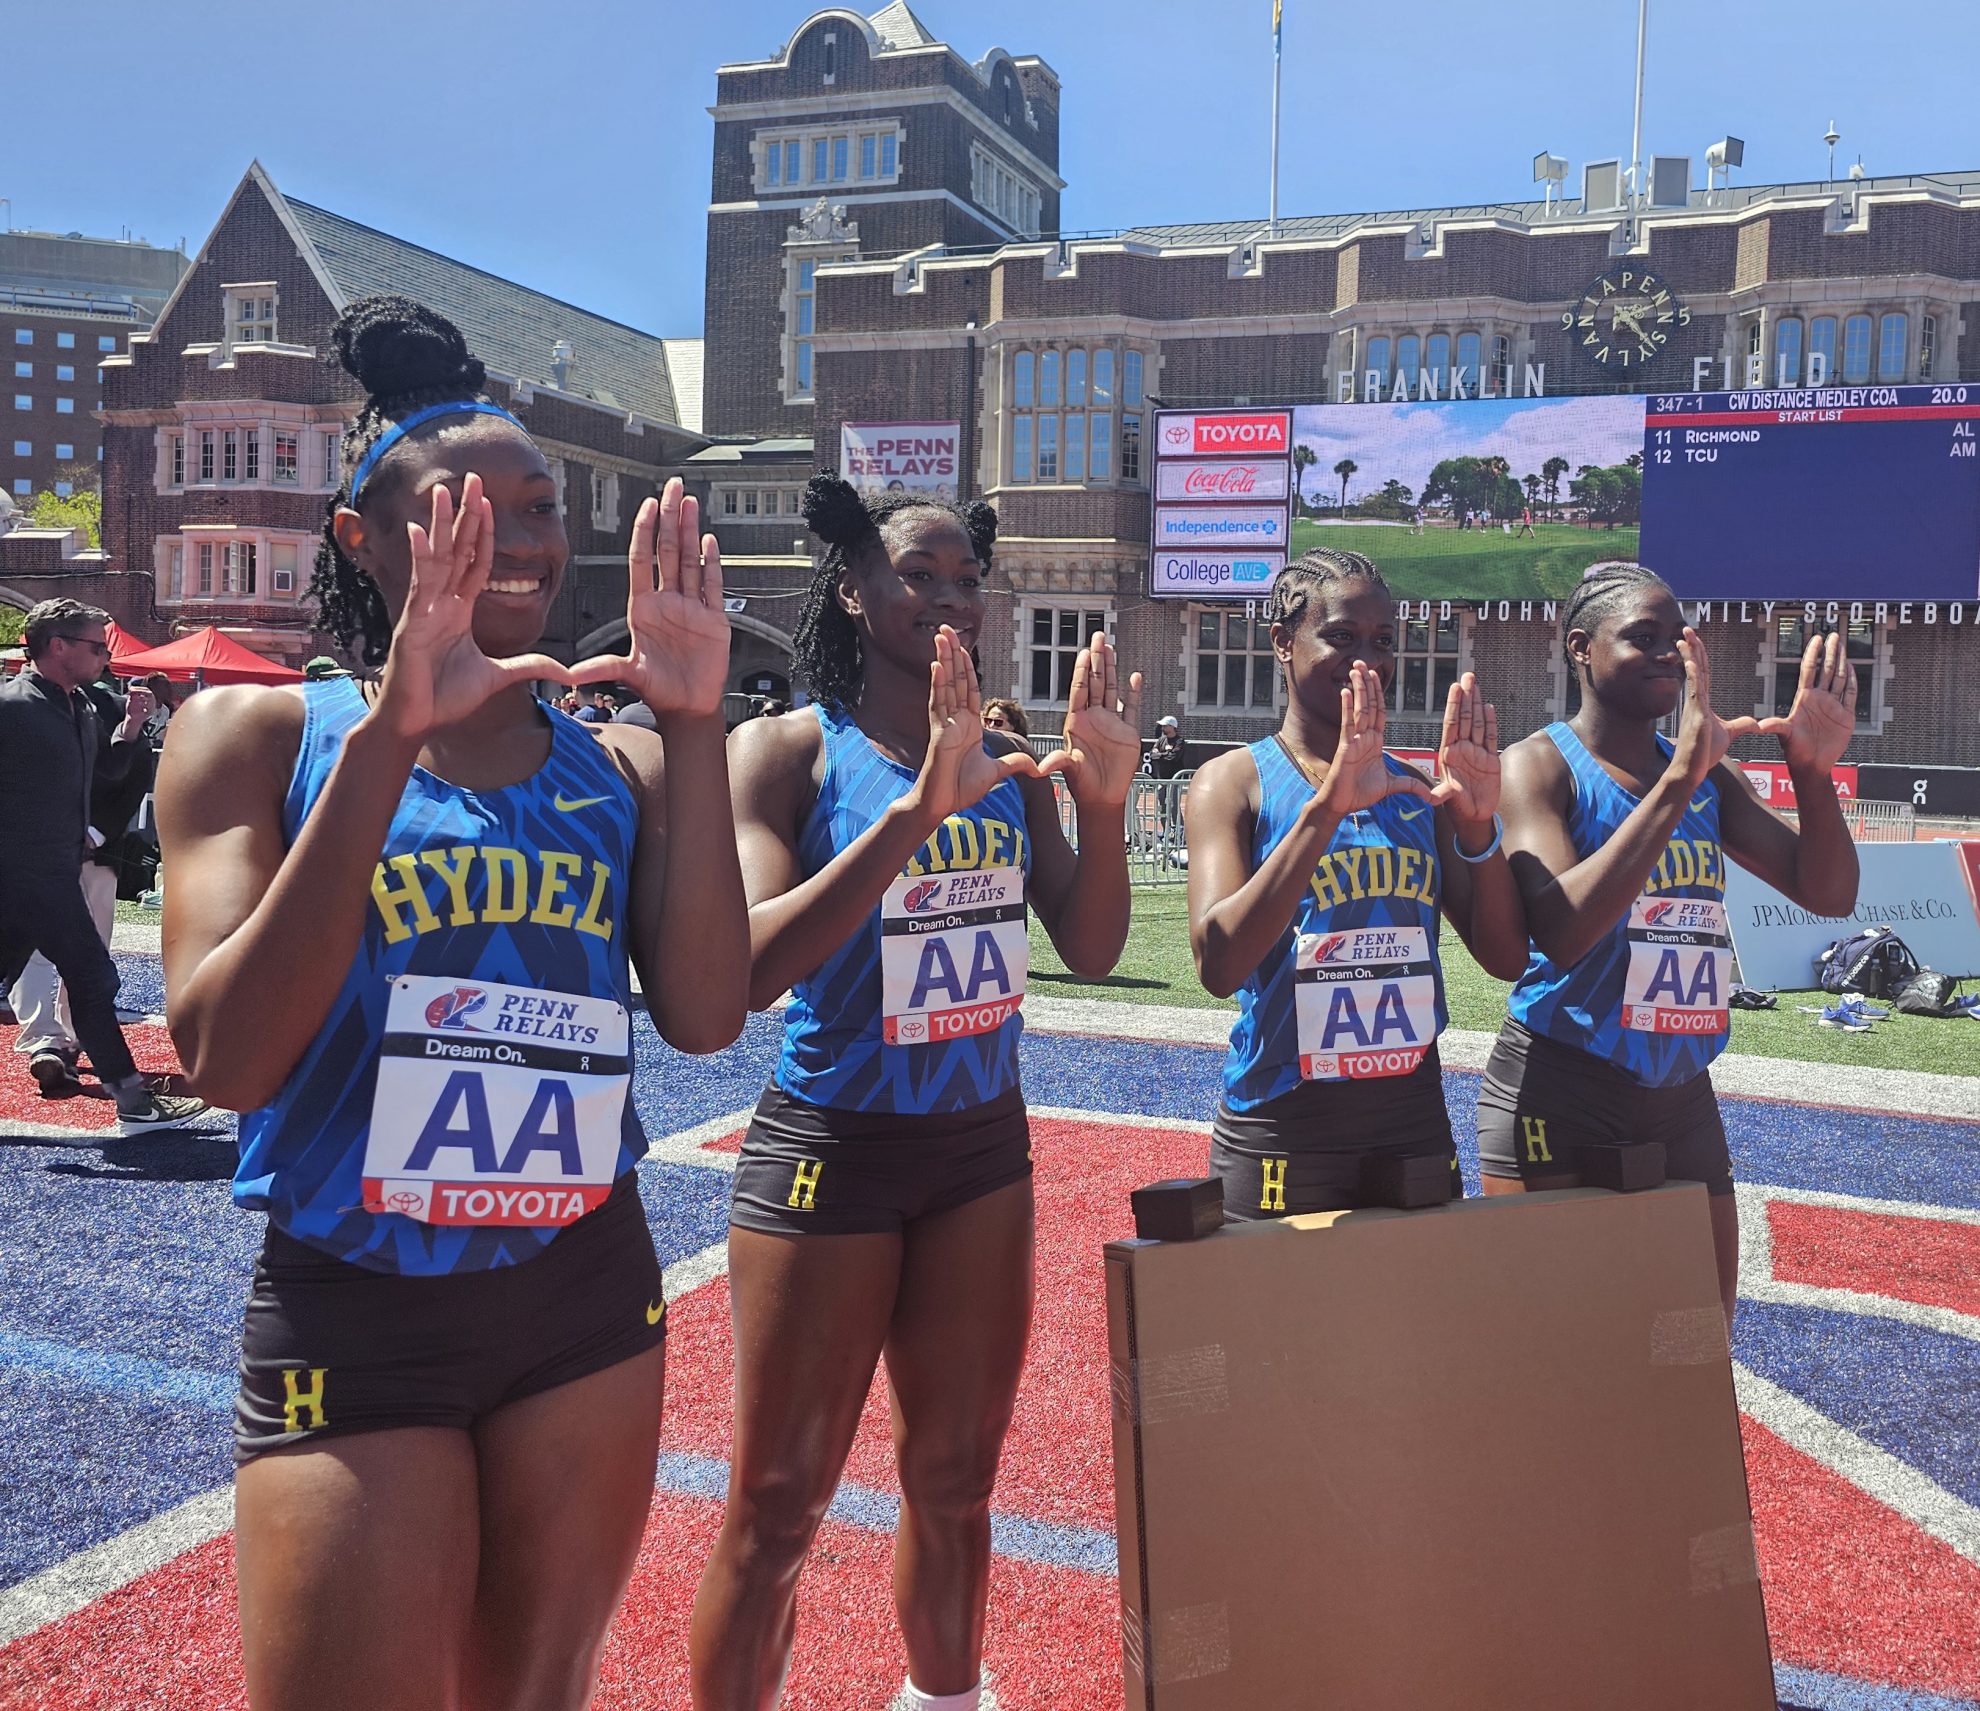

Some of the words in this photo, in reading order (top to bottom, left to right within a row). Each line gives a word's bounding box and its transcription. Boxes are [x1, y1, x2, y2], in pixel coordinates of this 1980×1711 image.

[1561, 312, 1574, 331] 9
[1678, 306, 1691, 326] 5
[1336, 363, 1545, 403] FRANKLIN
[1692, 352, 1827, 391] FIELD
[1728, 393, 1750, 410] CW
[1751, 391, 1813, 409] DISTANCE
[1815, 389, 1869, 407] MEDLEY
[1869, 389, 1899, 405] COA
[1931, 386, 1967, 404] 20.0
[1778, 411, 1816, 422] START
[1818, 410, 1844, 421] LIST
[1198, 424, 1282, 443] TOYOTA
[1655, 430, 1671, 444] 11
[1952, 421, 1975, 437] AL
[846, 447, 875, 456] THE
[877, 438, 954, 456] PENN
[1654, 449, 1672, 463] 12
[1685, 448, 1718, 463] TCU
[1949, 441, 1976, 457] AM
[847, 458, 954, 475] RELAYS
[1184, 466, 1259, 494] Coca-Cola
[1166, 519, 1259, 535] Independence
[1166, 559, 1230, 584] College
[1235, 564, 1262, 580] AVE
[949, 874, 995, 892] PENN
[1310, 846, 1436, 912] HYDEL
[370, 846, 614, 945] HYDEL
[945, 886, 1007, 907] RELAYS
[1679, 903, 1715, 916] PENN
[908, 919, 945, 933] Dream
[946, 915, 965, 927] On.
[1678, 916, 1718, 929] RELAYS
[1352, 932, 1398, 946] PENN
[1646, 931, 1679, 943] Dream
[1680, 933, 1697, 944] On.
[1351, 945, 1411, 960] RELAYS
[908, 930, 1012, 1009] AA
[1316, 969, 1354, 981] Dream
[1356, 968, 1375, 979] On.
[1642, 948, 1718, 1006] AA
[500, 993, 580, 1021] PENN
[1320, 983, 1418, 1050] AA
[493, 1012, 600, 1045] RELAYS
[934, 1002, 1014, 1036] TOYOTA
[1659, 1012, 1719, 1029] TOYOTA
[424, 1037, 491, 1060] Dream
[494, 1044, 528, 1065] On.
[1343, 1052, 1424, 1075] TOYOTA
[402, 1070, 584, 1176] AA
[1521, 1116, 1553, 1162] H
[788, 1160, 824, 1209] H
[1260, 1158, 1288, 1211] H
[441, 1188, 586, 1220] TOYOTA
[282, 1367, 330, 1433] H
